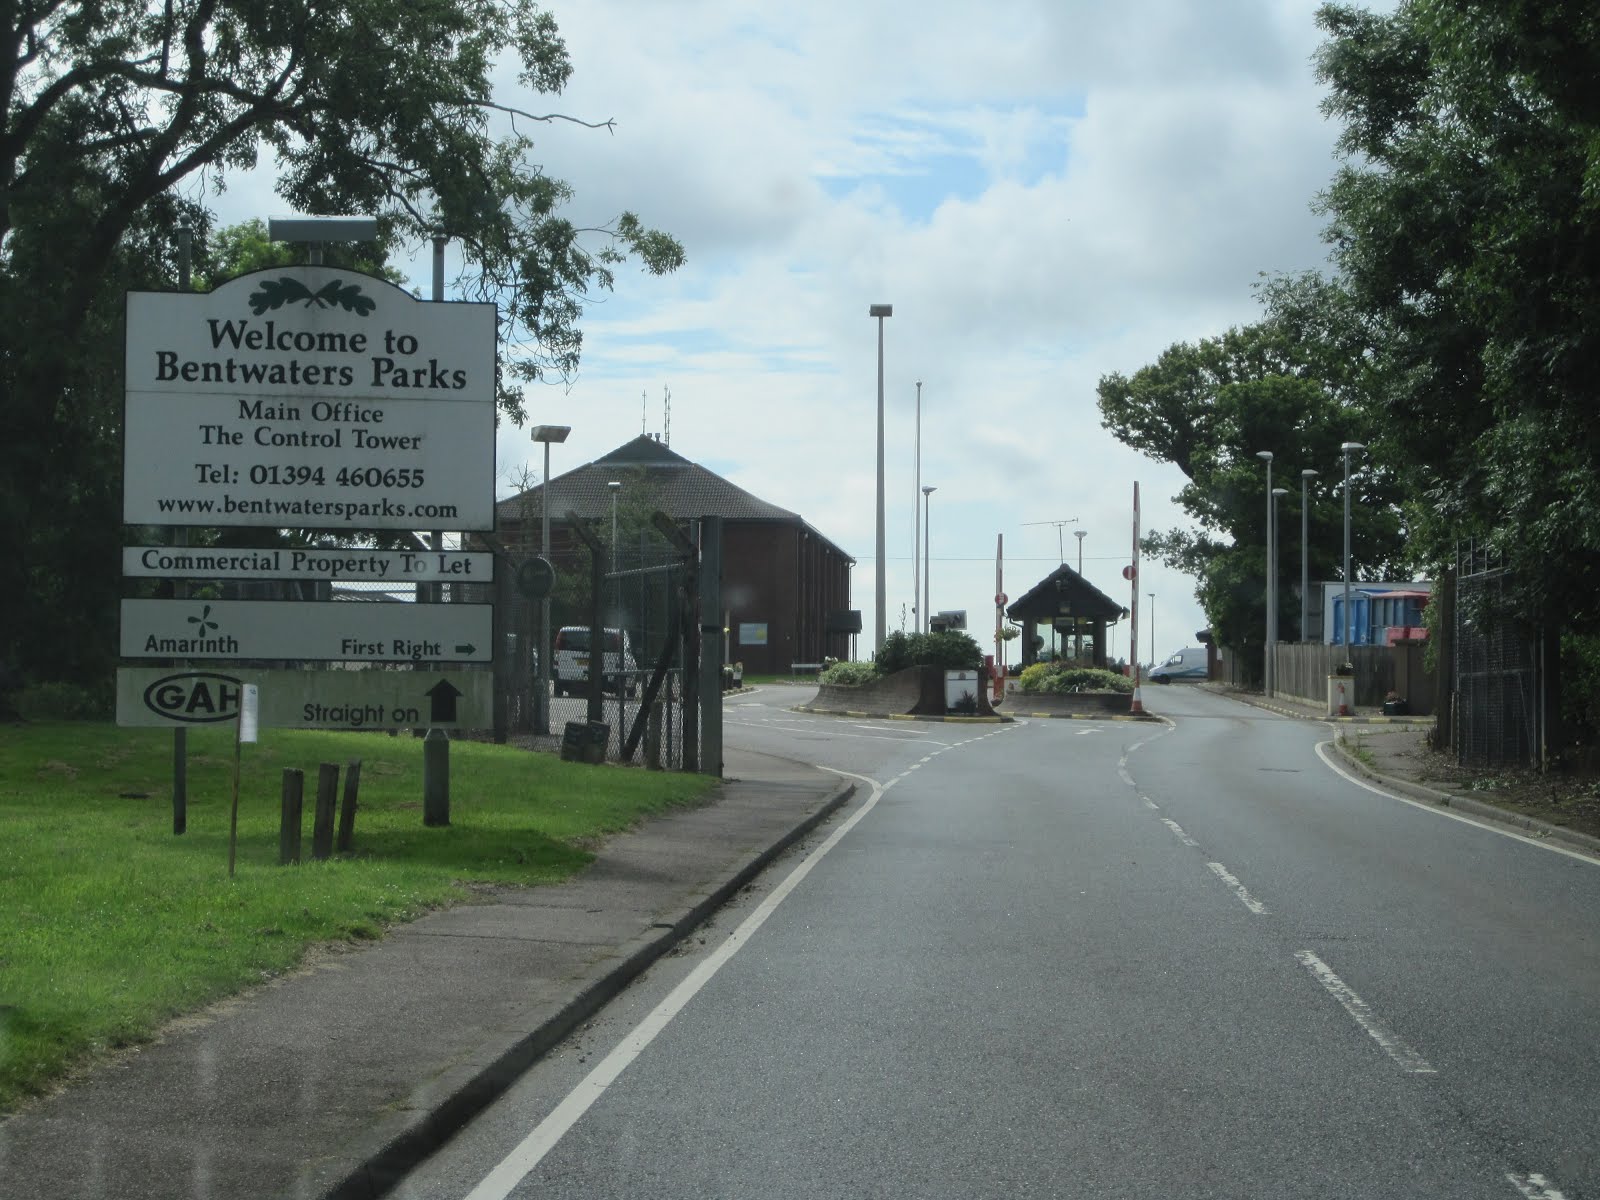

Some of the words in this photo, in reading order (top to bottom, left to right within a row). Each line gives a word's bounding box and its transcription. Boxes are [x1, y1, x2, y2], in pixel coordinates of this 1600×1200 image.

[206, 318, 367, 353] Welcome
[385, 329, 419, 355] to
[155, 351, 354, 387] Bentwaters
[371, 357, 467, 390] Parks
[238, 400, 301, 422] Main
[311, 401, 384, 423] Office
[199, 425, 243, 446] The
[254, 427, 342, 449] Control
[352, 430, 421, 450] Tower
[195, 464, 239, 484] Tel:
[250, 465, 326, 487] 01394
[335, 467, 425, 489] 460655
[157, 495, 458, 520] www.bentwatersparks.com
[141, 549, 280, 571] Commercial
[291, 553, 390, 577] Property
[399, 554, 427, 574] To
[438, 555, 472, 574] Let
[144, 634, 239, 654] Amarinth
[341, 639, 384, 656] First
[392, 639, 441, 660] Right
[303, 703, 384, 726] Straight
[391, 708, 418, 723] on
